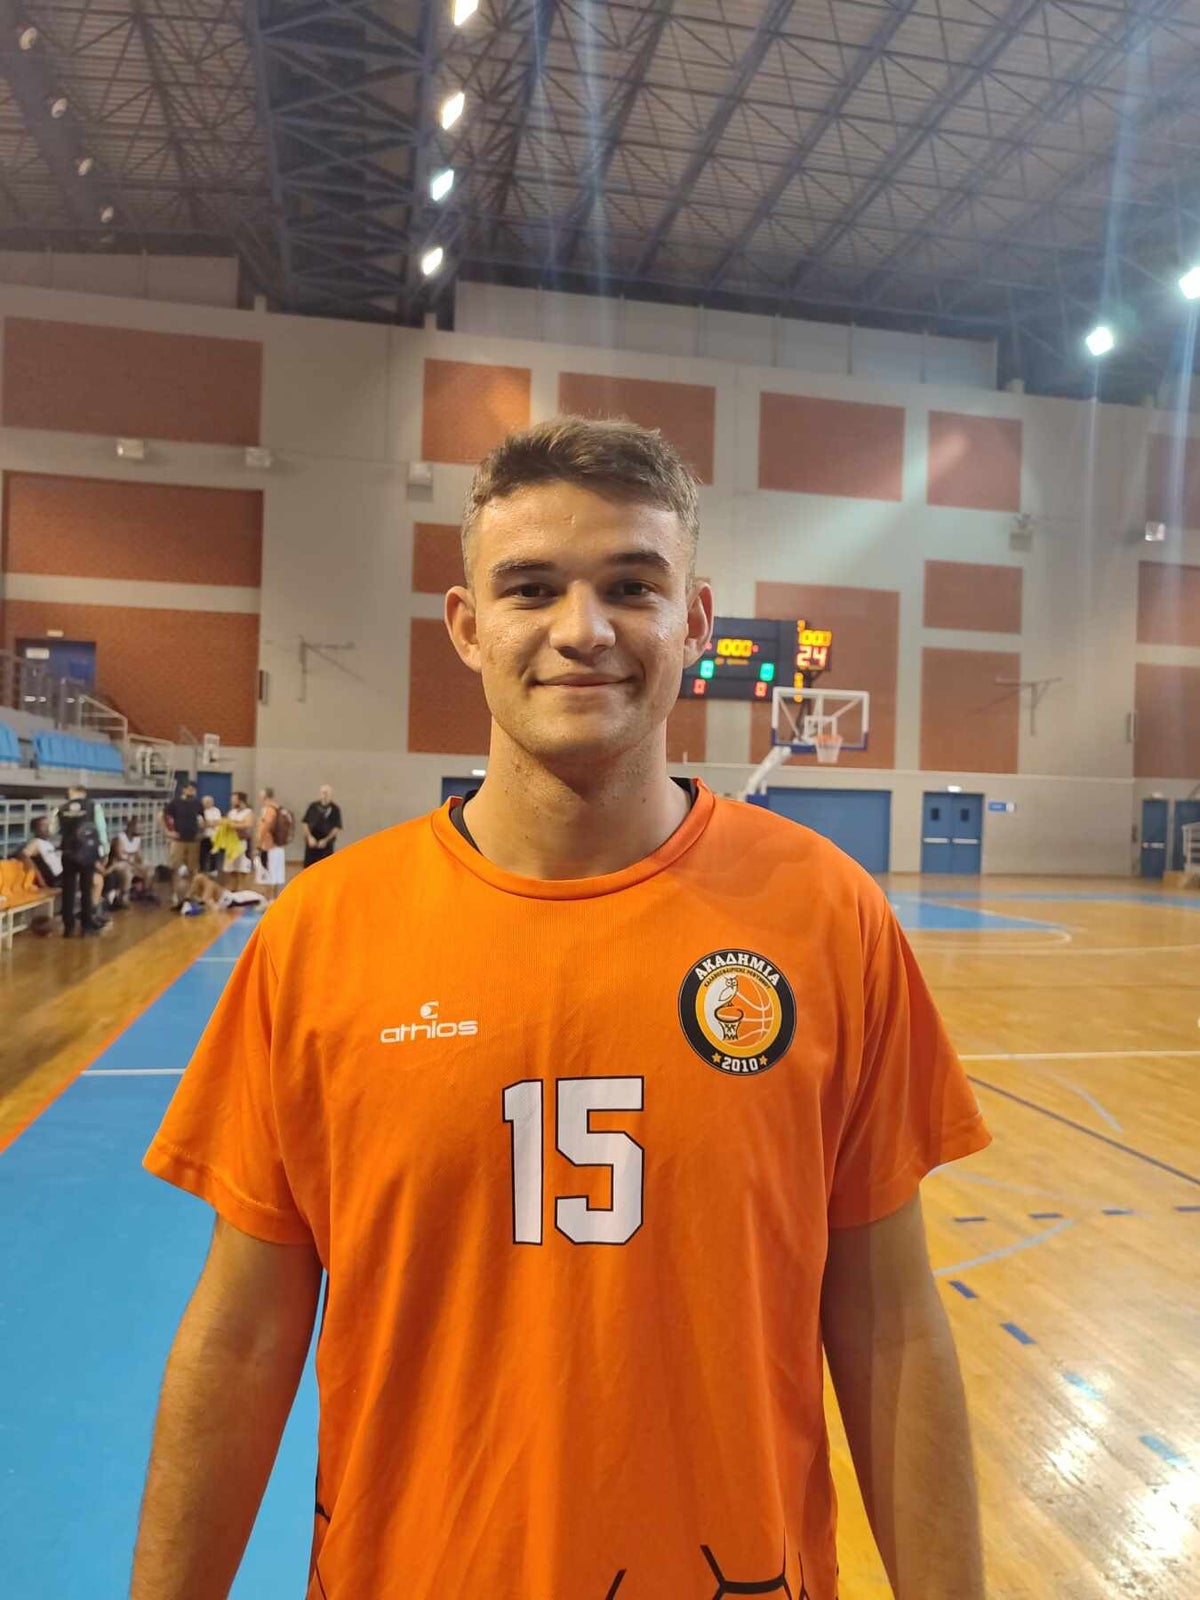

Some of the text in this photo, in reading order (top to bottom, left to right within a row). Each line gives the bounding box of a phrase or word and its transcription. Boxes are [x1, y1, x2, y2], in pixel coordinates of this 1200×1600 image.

[796, 646, 827, 668] 24
[695, 953, 780, 986] ΑΚΑΔΗΜΙΑ
[721, 1056, 758, 1072] 2010
[502, 1076, 644, 1245] 15
